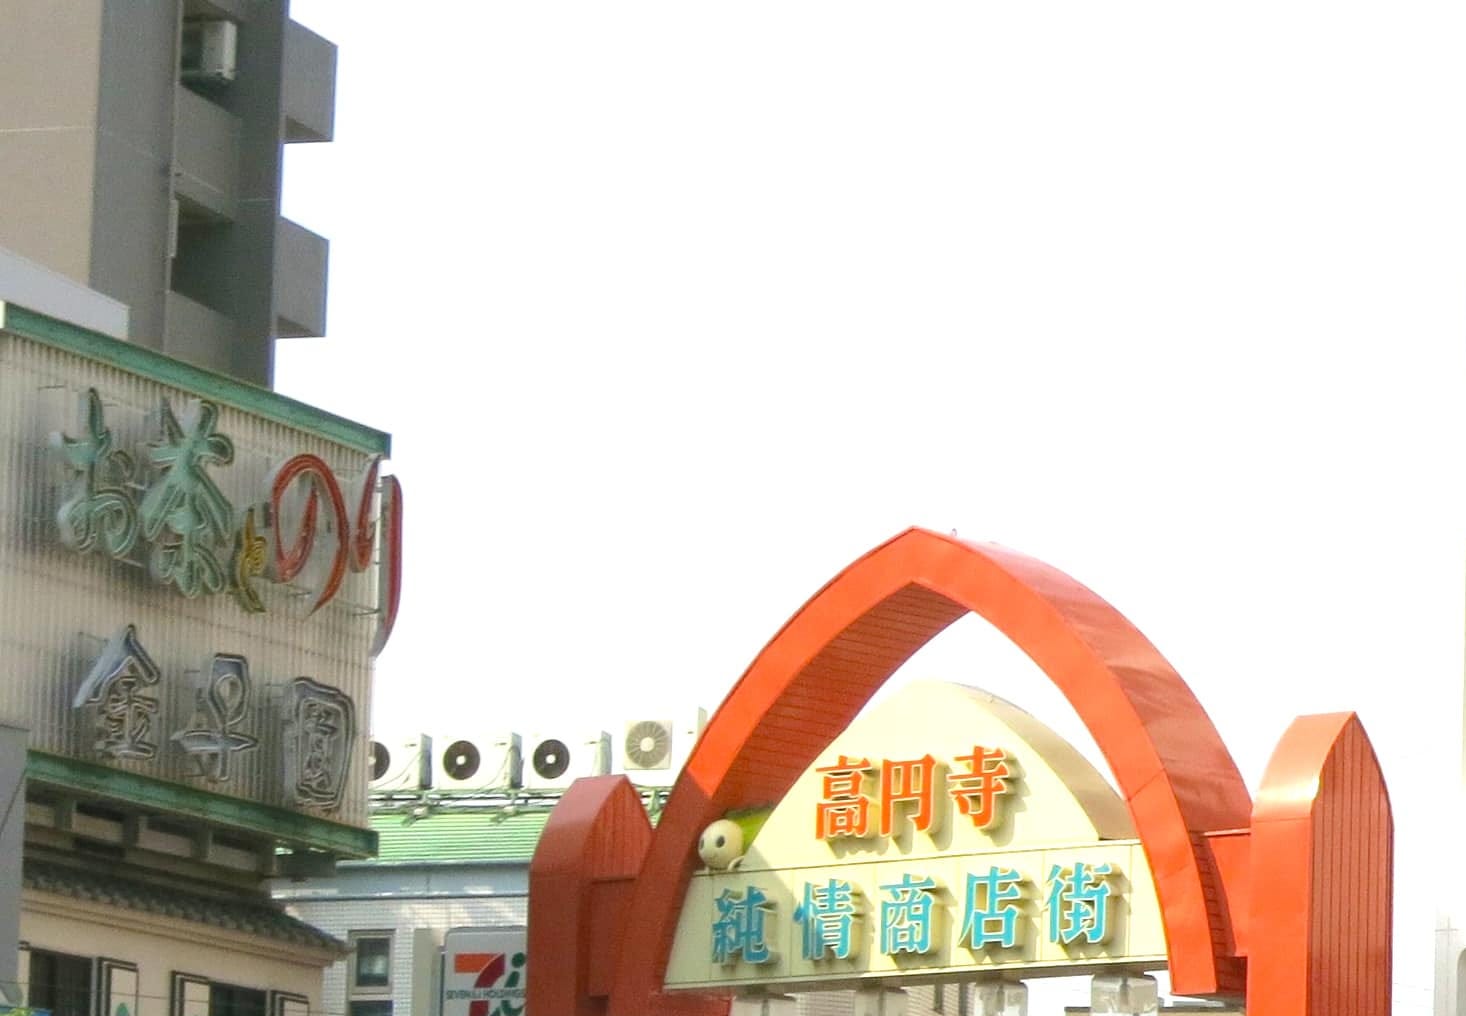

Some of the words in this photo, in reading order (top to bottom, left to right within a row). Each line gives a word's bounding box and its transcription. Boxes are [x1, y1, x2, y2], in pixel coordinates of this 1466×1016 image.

[815, 745, 1011, 841] 高円寺
[712, 862, 1112, 965] 純情商店街
